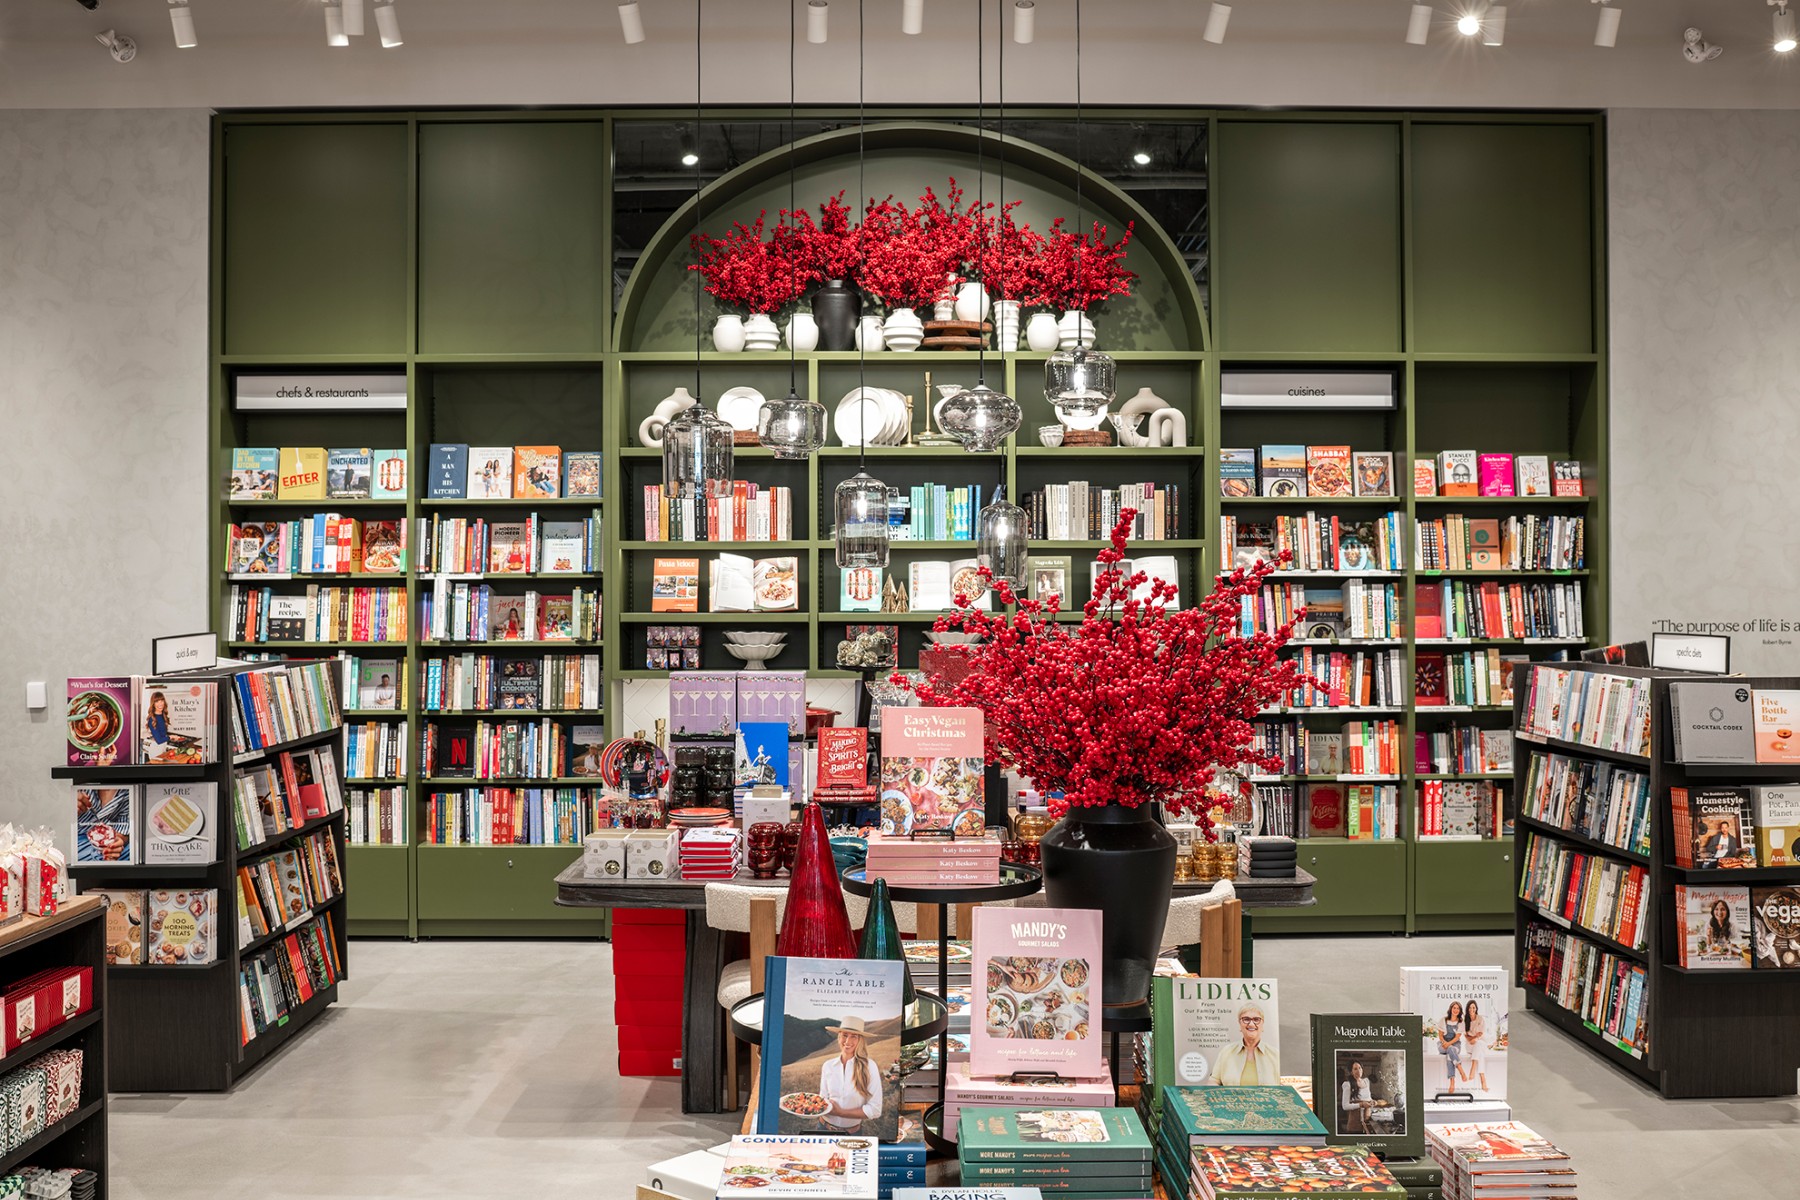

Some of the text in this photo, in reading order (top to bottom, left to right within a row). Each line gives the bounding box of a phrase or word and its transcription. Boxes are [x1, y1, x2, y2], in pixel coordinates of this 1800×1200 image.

[276, 386, 368, 398] chefs & restaurants
[1288, 386, 1326, 396] cuisines
[331, 458, 368, 466] UNCHARTED
[282, 472, 319, 487] EATER
[495, 599, 515, 613] just
[1687, 622, 1739, 635] purpose
[1743, 619, 1757, 632] of
[1759, 619, 1777, 632] life
[1780, 620, 1790, 632] is
[1794, 623, 1800, 632] a
[364, 668, 372, 681] 5
[181, 699, 200, 708] Mary's
[904, 715, 966, 728] Easy Vegan
[904, 727, 966, 737] Christmas
[451, 738, 467, 764] N
[828, 750, 858, 762] SPIRITS
[829, 760, 855, 774] BRIGHT
[163, 787, 191, 796] MORE
[1696, 796, 1744, 805] Homestyle
[1702, 806, 1740, 814] Cooking
[151, 843, 202, 854] THAN CAKE
[1691, 891, 1747, 904] Mostly Veggies
[1756, 905, 1800, 923] vega
[1010, 922, 1068, 939] MANDY'S
[1537, 929, 1553, 939] BAD
[835, 968, 853, 976] The
[803, 978, 842, 986] RANCH
[1179, 983, 1271, 1000] LIDIA'S
[1628, 979, 1636, 1015] SOUP
[1634, 981, 1642, 1018] SOUP
[1335, 1026, 1405, 1038] Magnolia Table
[1064, 1049, 1077, 1058] life
[1442, 1122, 1518, 1136] just eat
[852, 1150, 869, 1174] ELICIOUS
[1319, 1157, 1347, 1177] Cook
